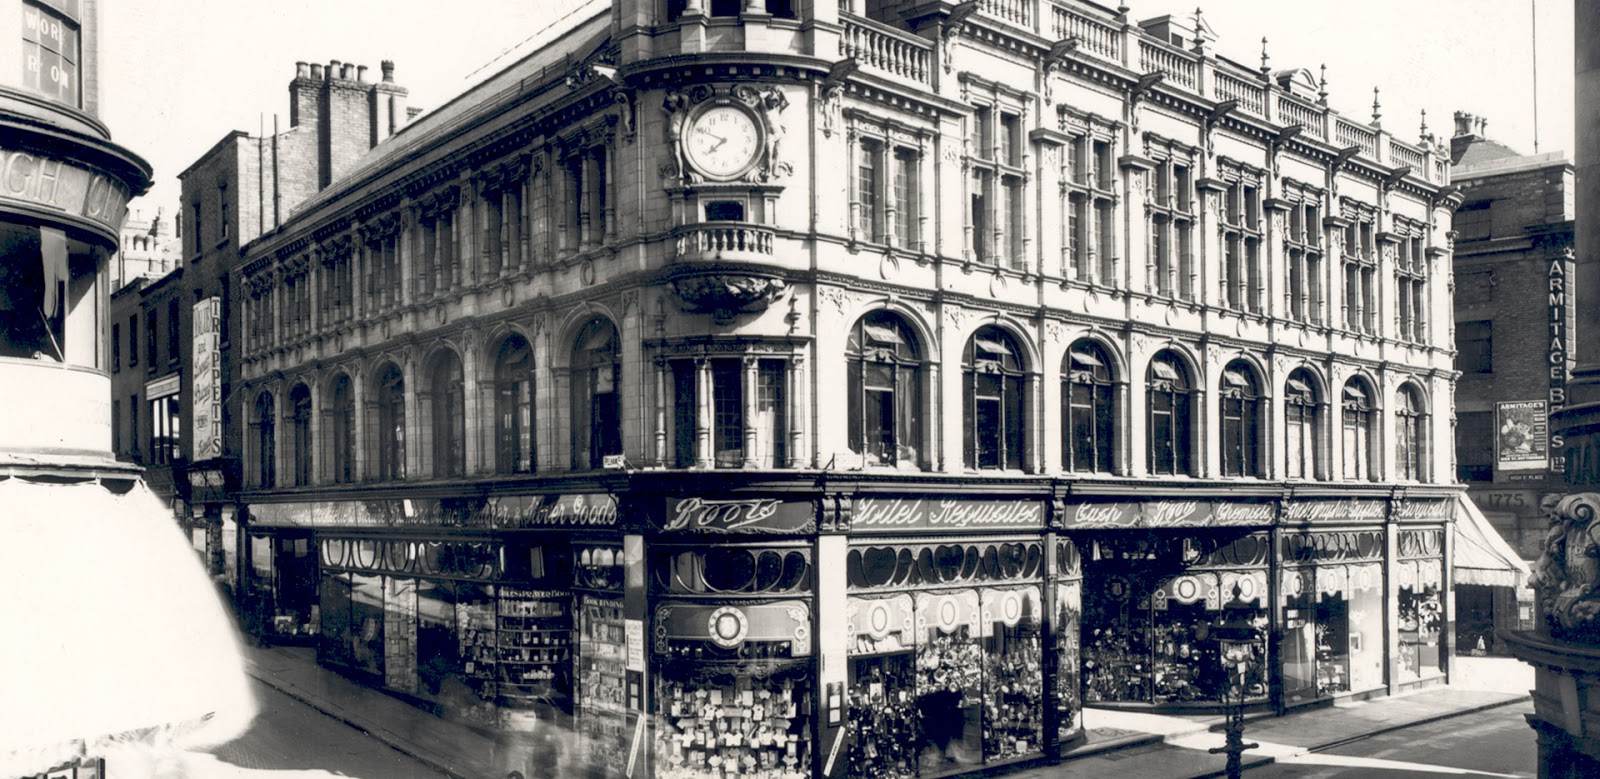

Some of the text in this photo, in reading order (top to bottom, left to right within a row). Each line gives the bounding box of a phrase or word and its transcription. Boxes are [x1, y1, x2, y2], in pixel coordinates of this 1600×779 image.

[1549, 258, 1564, 379] ARMITAGE
[210, 299, 221, 454] TRIPPETTS
[1500, 402, 1544, 410] ARMITAGE'S
[570, 494, 617, 525] Goods
[664, 498, 783, 529] Boots
[850, 498, 922, 524] Toilet
[1399, 498, 1446, 520] Surgical
